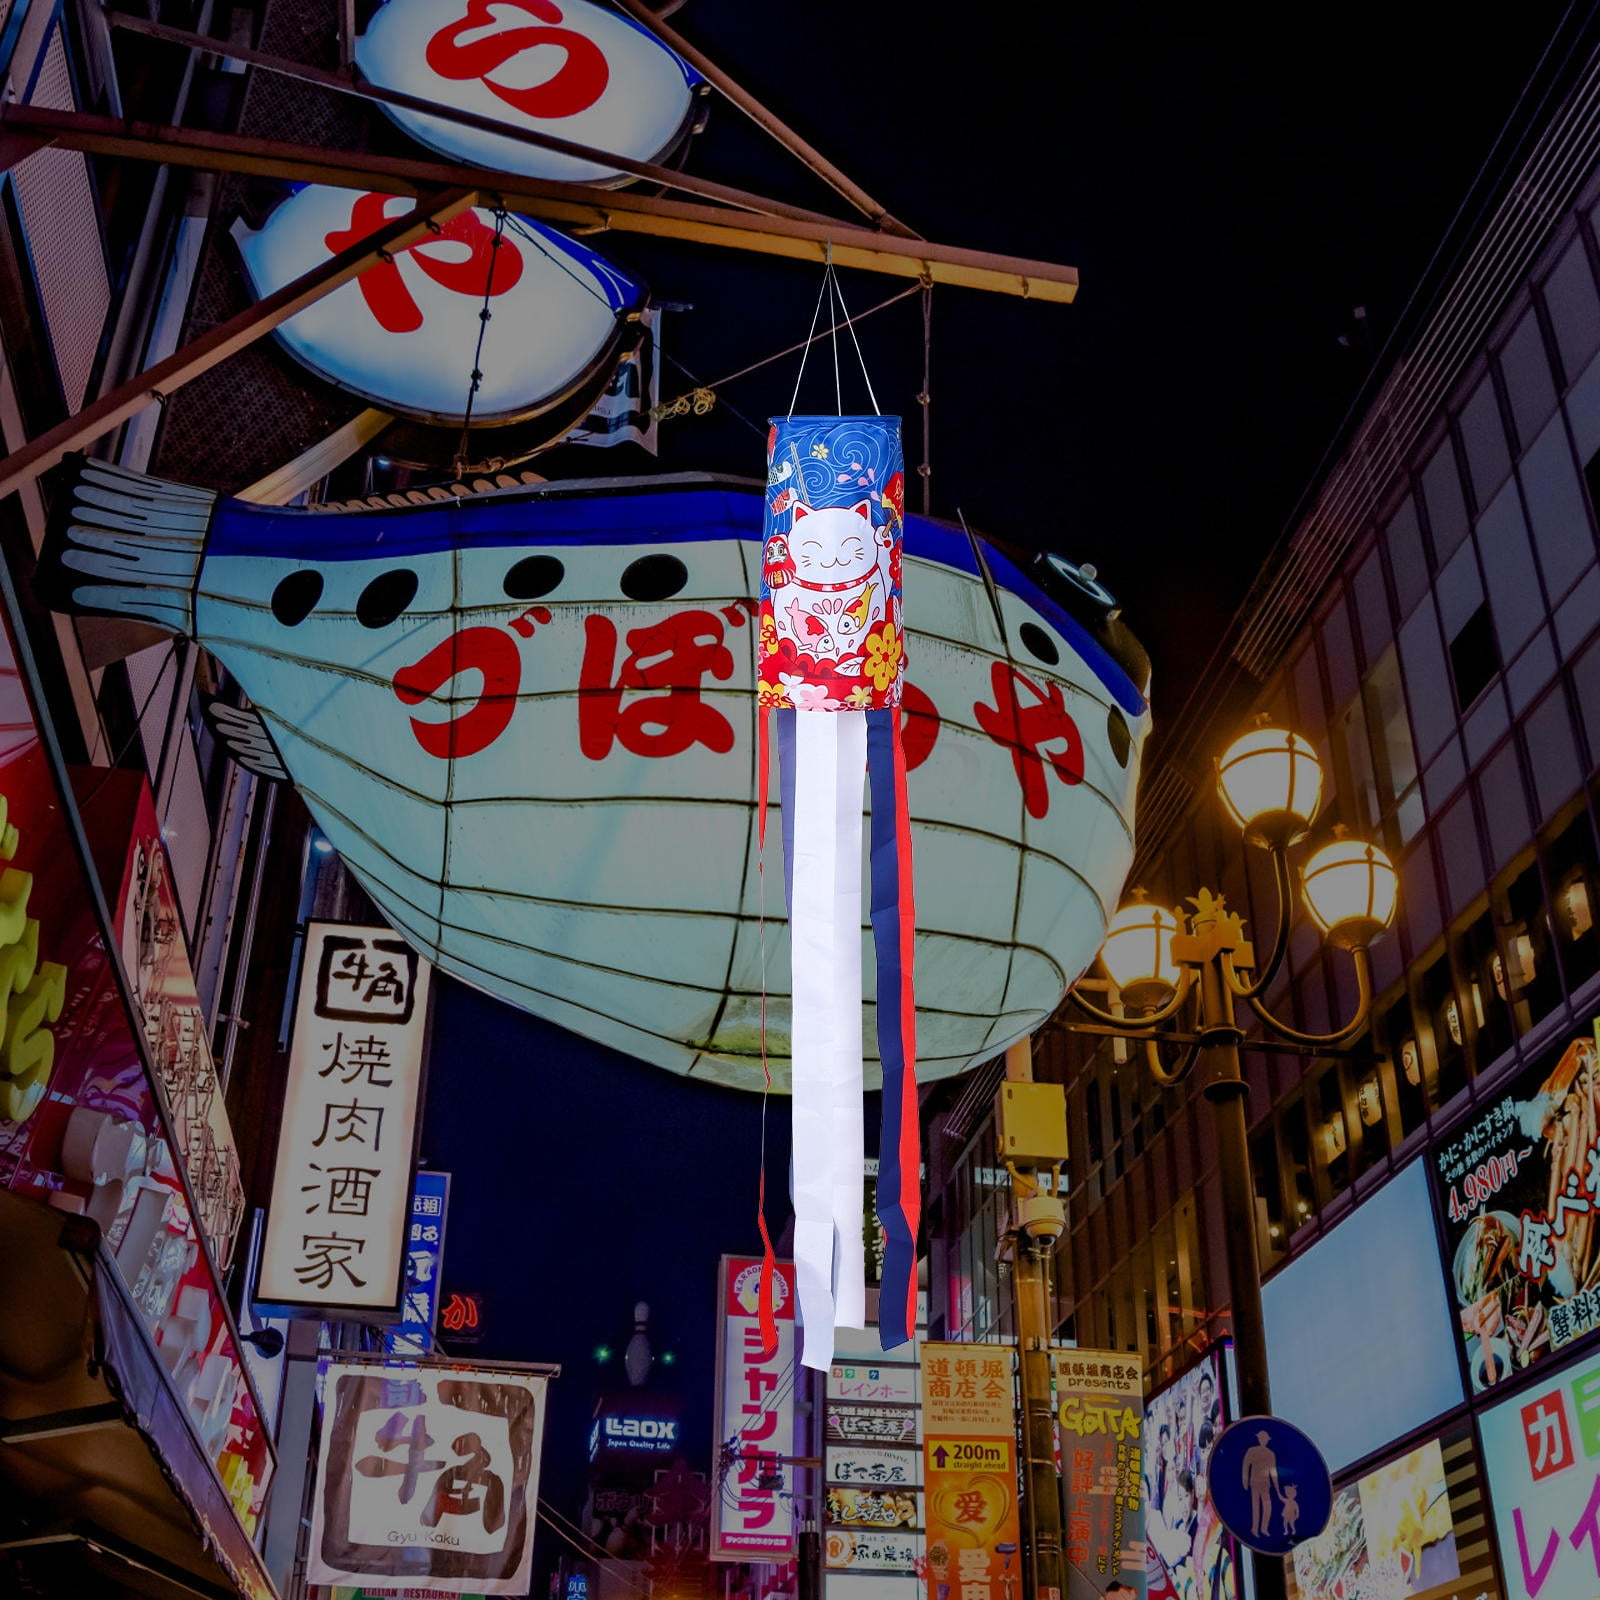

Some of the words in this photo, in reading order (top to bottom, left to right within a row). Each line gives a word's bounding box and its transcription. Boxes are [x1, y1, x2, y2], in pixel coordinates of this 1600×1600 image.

[324, 192, 523, 333] や
[392, 599, 1085, 819] づぼや
[331, 951, 405, 1005] 牛角
[294, 1031, 393, 1289] 焼肉酒家
[927, 1358, 1004, 1380] 道頓堀
[927, 1377, 1006, 1399] 商店会
[1068, 1378, 1131, 1390] presents
[607, 1438, 627, 1448] Japan
[629, 1440, 655, 1450] Quality
[656, 1442, 671, 1450] Life
[953, 1444, 1001, 1460] 200m
[355, 1411, 506, 1535] 牛角
[953, 1461, 982, 1470] straight
[984, 1462, 1006, 1470] ahead
[1068, 1447, 1095, 1567] 好評上演中
[387, 1530, 417, 1545] Gyu
[424, 1531, 460, 1546] Kaku
